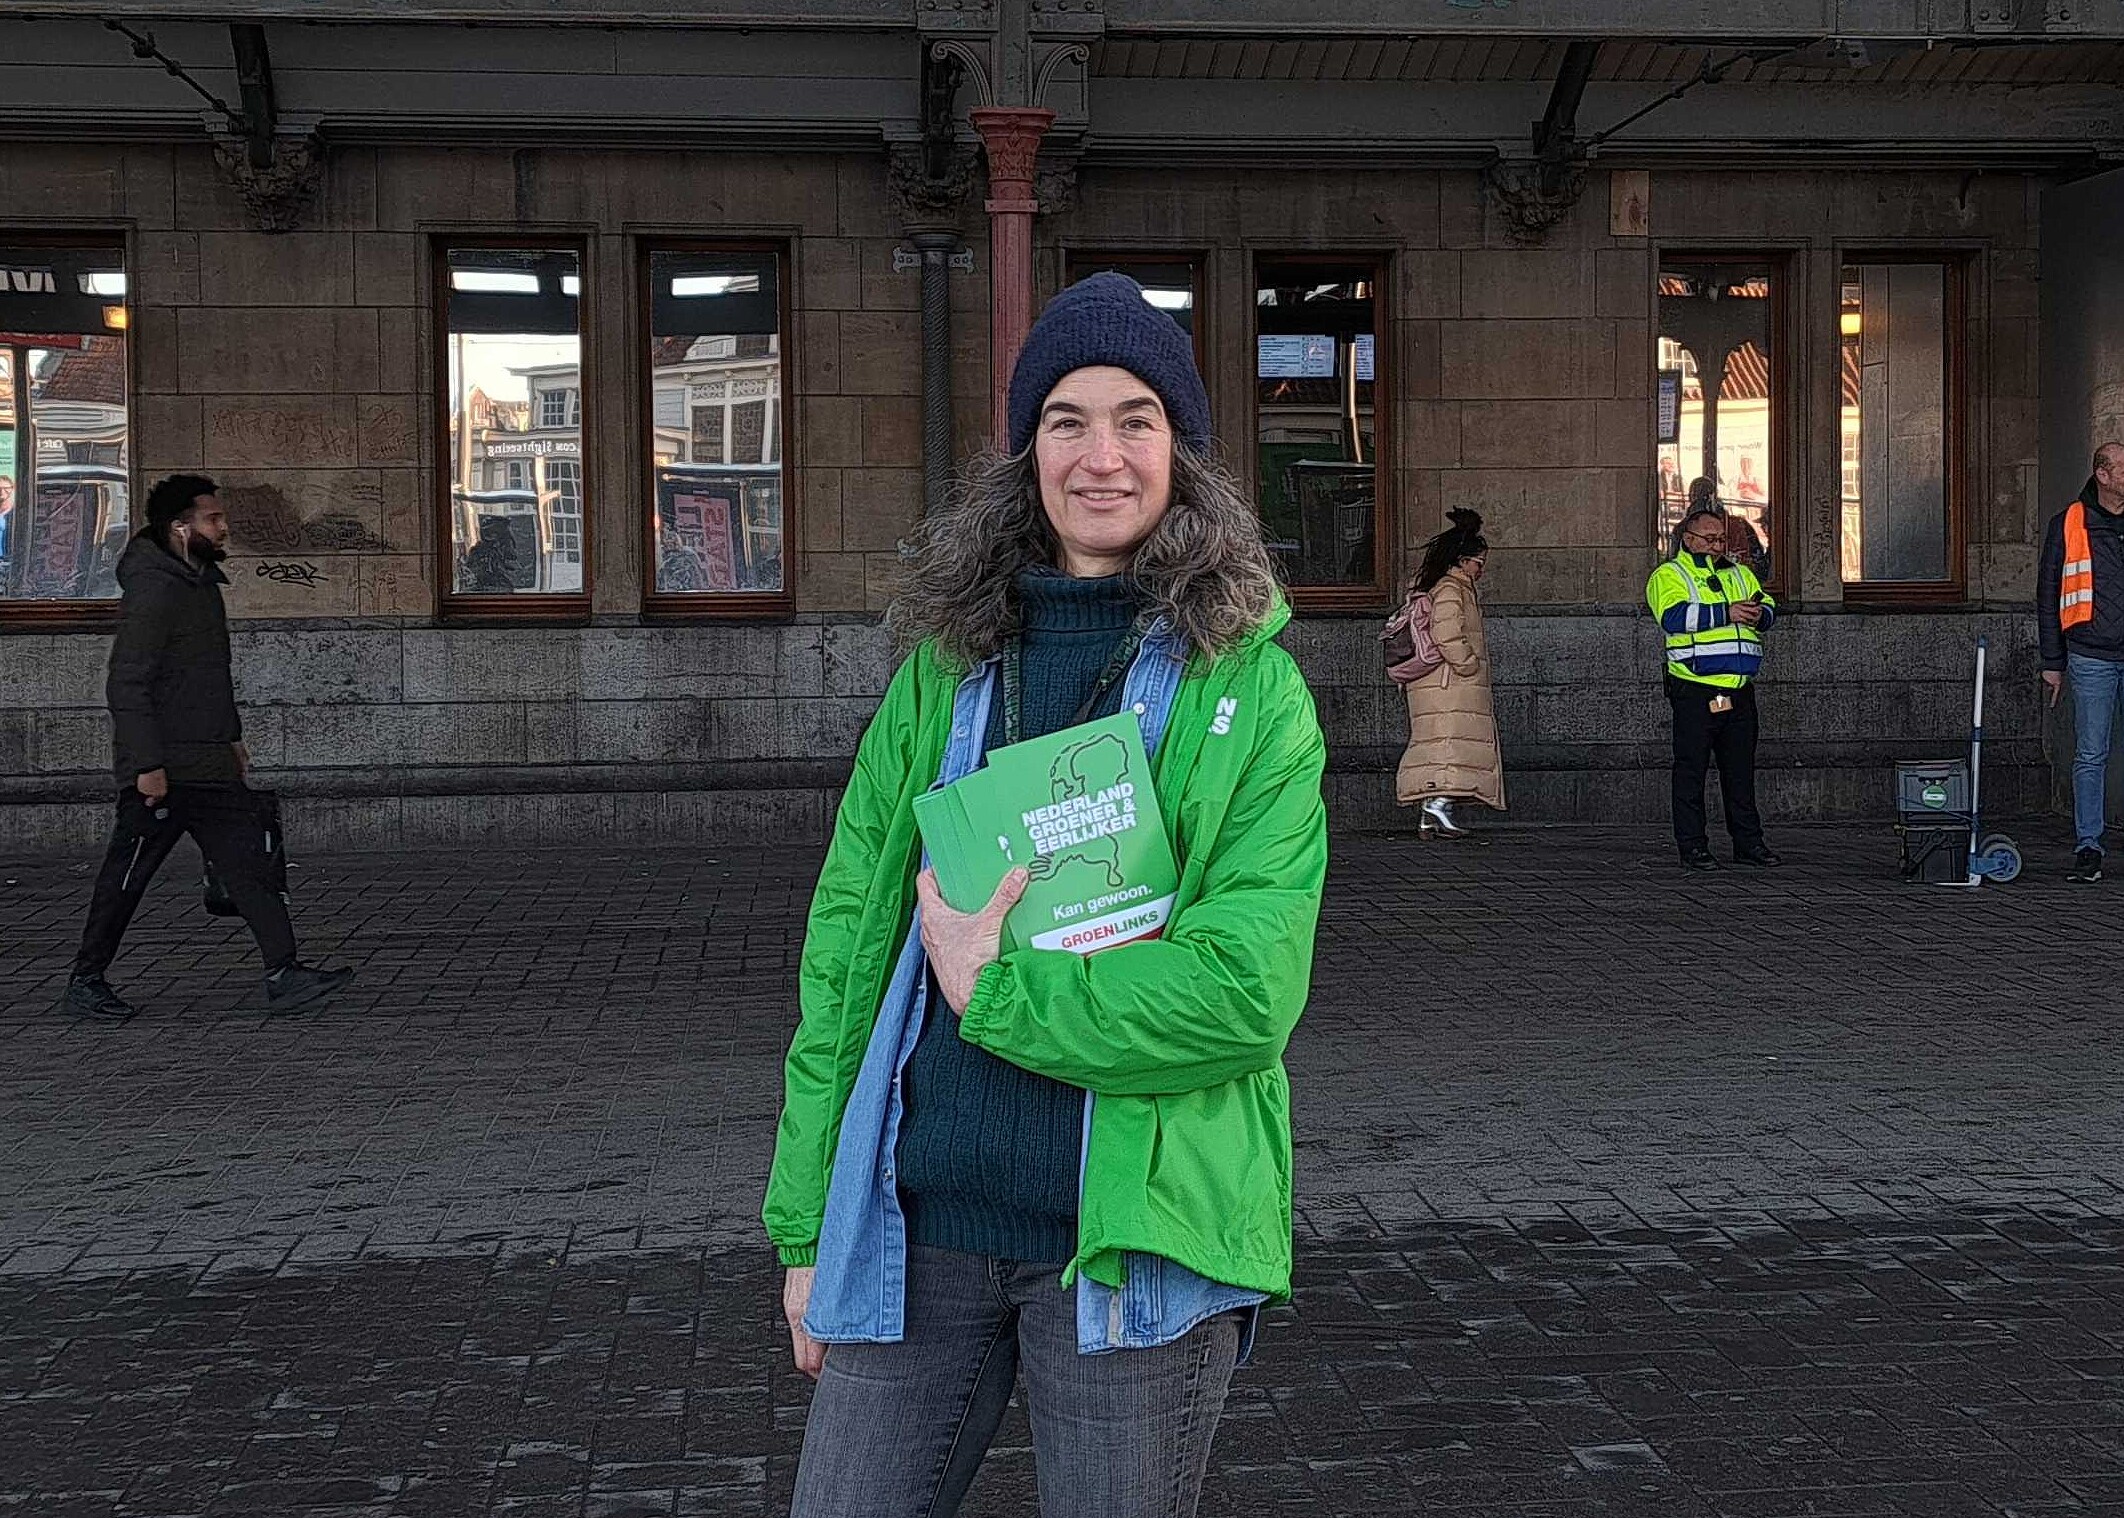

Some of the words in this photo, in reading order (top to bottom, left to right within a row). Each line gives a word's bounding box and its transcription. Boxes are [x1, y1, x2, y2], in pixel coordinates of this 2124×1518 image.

[1021, 782, 1134, 827] NEDERLAND
[1028, 802, 1118, 840] GROENER
[1123, 798, 1137, 813] &
[1035, 813, 1137, 855] EERLIJKER
[1052, 902, 1084, 921] Kan
[1087, 884, 1153, 914] gewoon.
[1061, 910, 1159, 949] GROENLINKS
